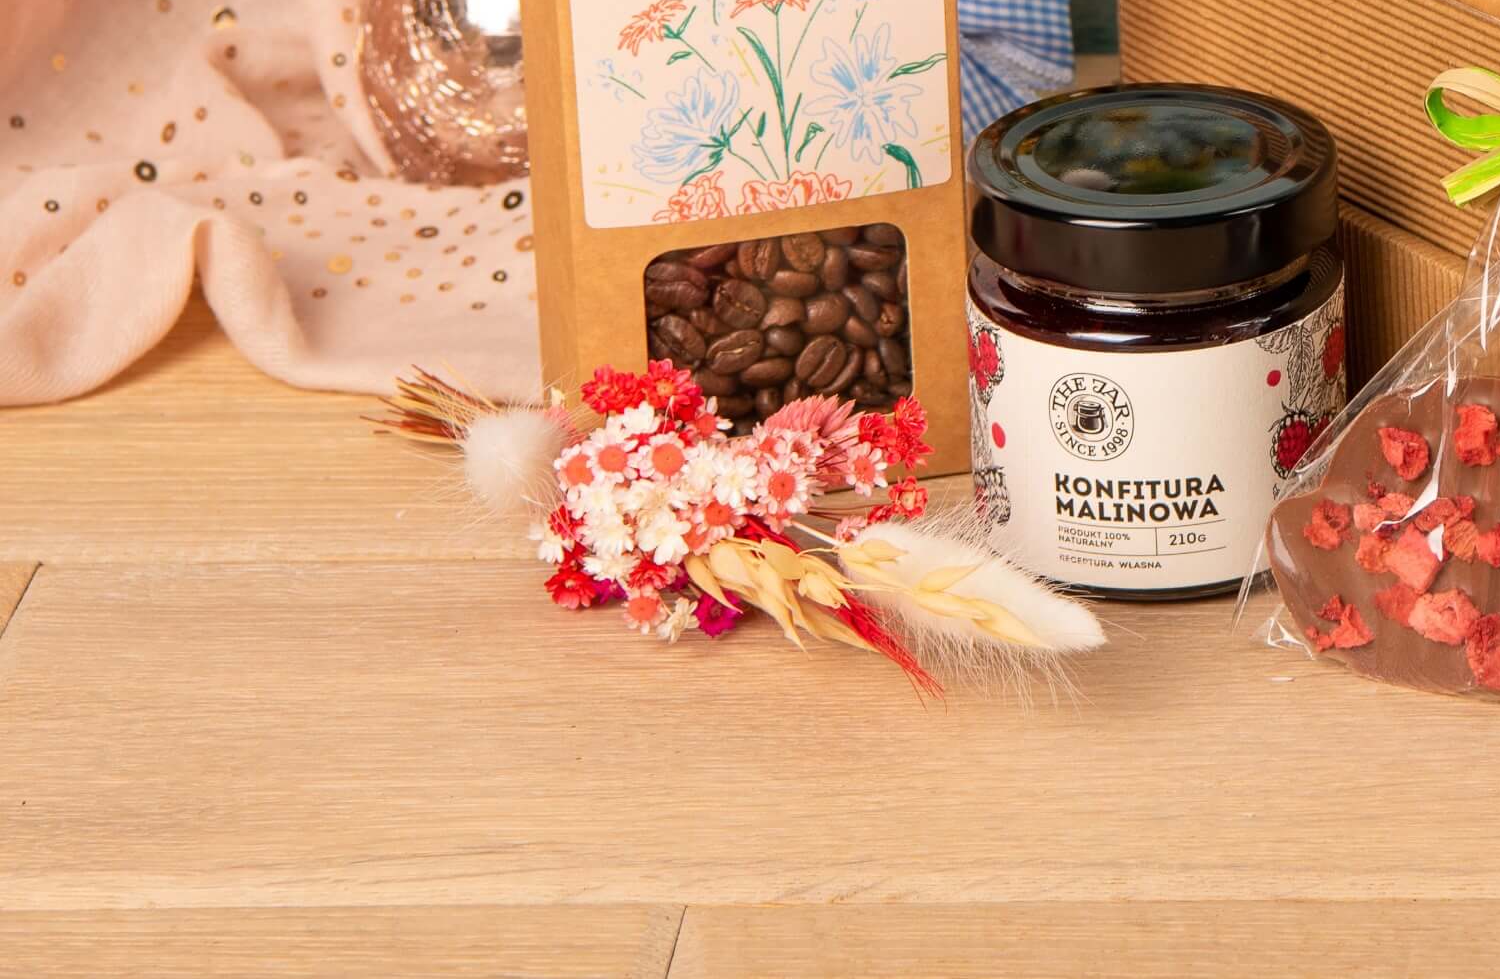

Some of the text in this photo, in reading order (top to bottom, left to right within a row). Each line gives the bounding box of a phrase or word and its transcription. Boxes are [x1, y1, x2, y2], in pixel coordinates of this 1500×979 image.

[1052, 376, 1130, 421] THE JAR
[1055, 421, 1129, 457] SINCE 1998
[1055, 472, 1225, 500] KONFITURA
[1056, 496, 1219, 522] MALINOWA
[1058, 525, 1131, 541] PRODUKT 100%
[1058, 535, 1114, 548] NATURALNY
[1059, 554, 1115, 568] RECEPTURA
